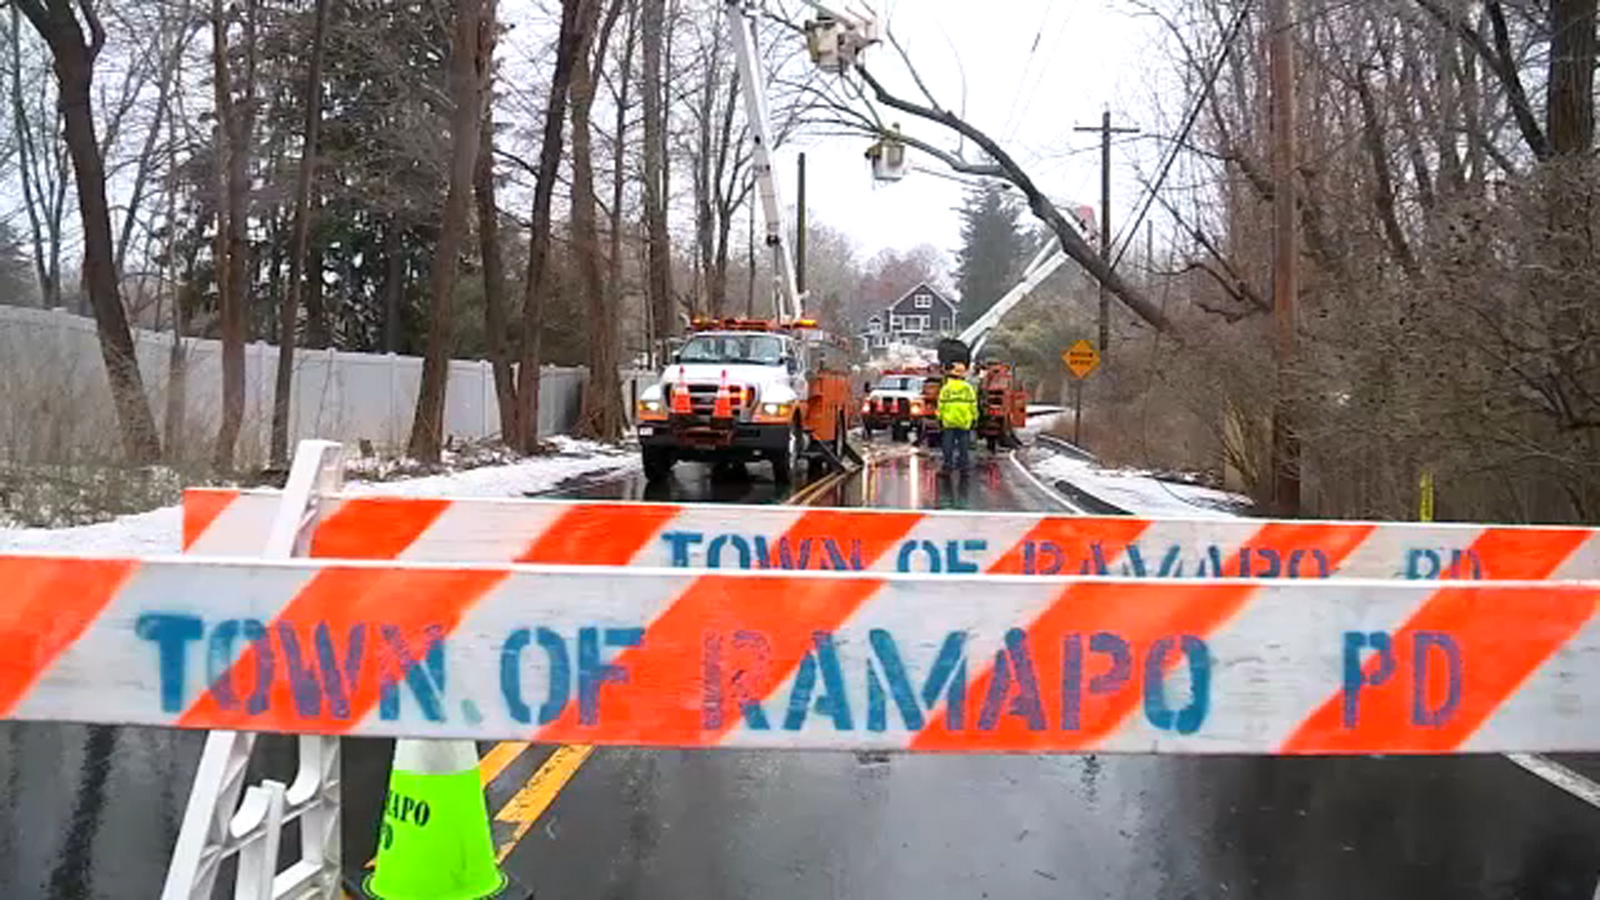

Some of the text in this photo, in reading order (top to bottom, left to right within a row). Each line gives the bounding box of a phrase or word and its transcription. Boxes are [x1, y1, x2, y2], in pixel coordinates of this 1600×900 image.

[661, 532, 865, 571] TOWN
[897, 538, 988, 574] OF
[135, 612, 1463, 734] TOWN OF RAMAPO PD
